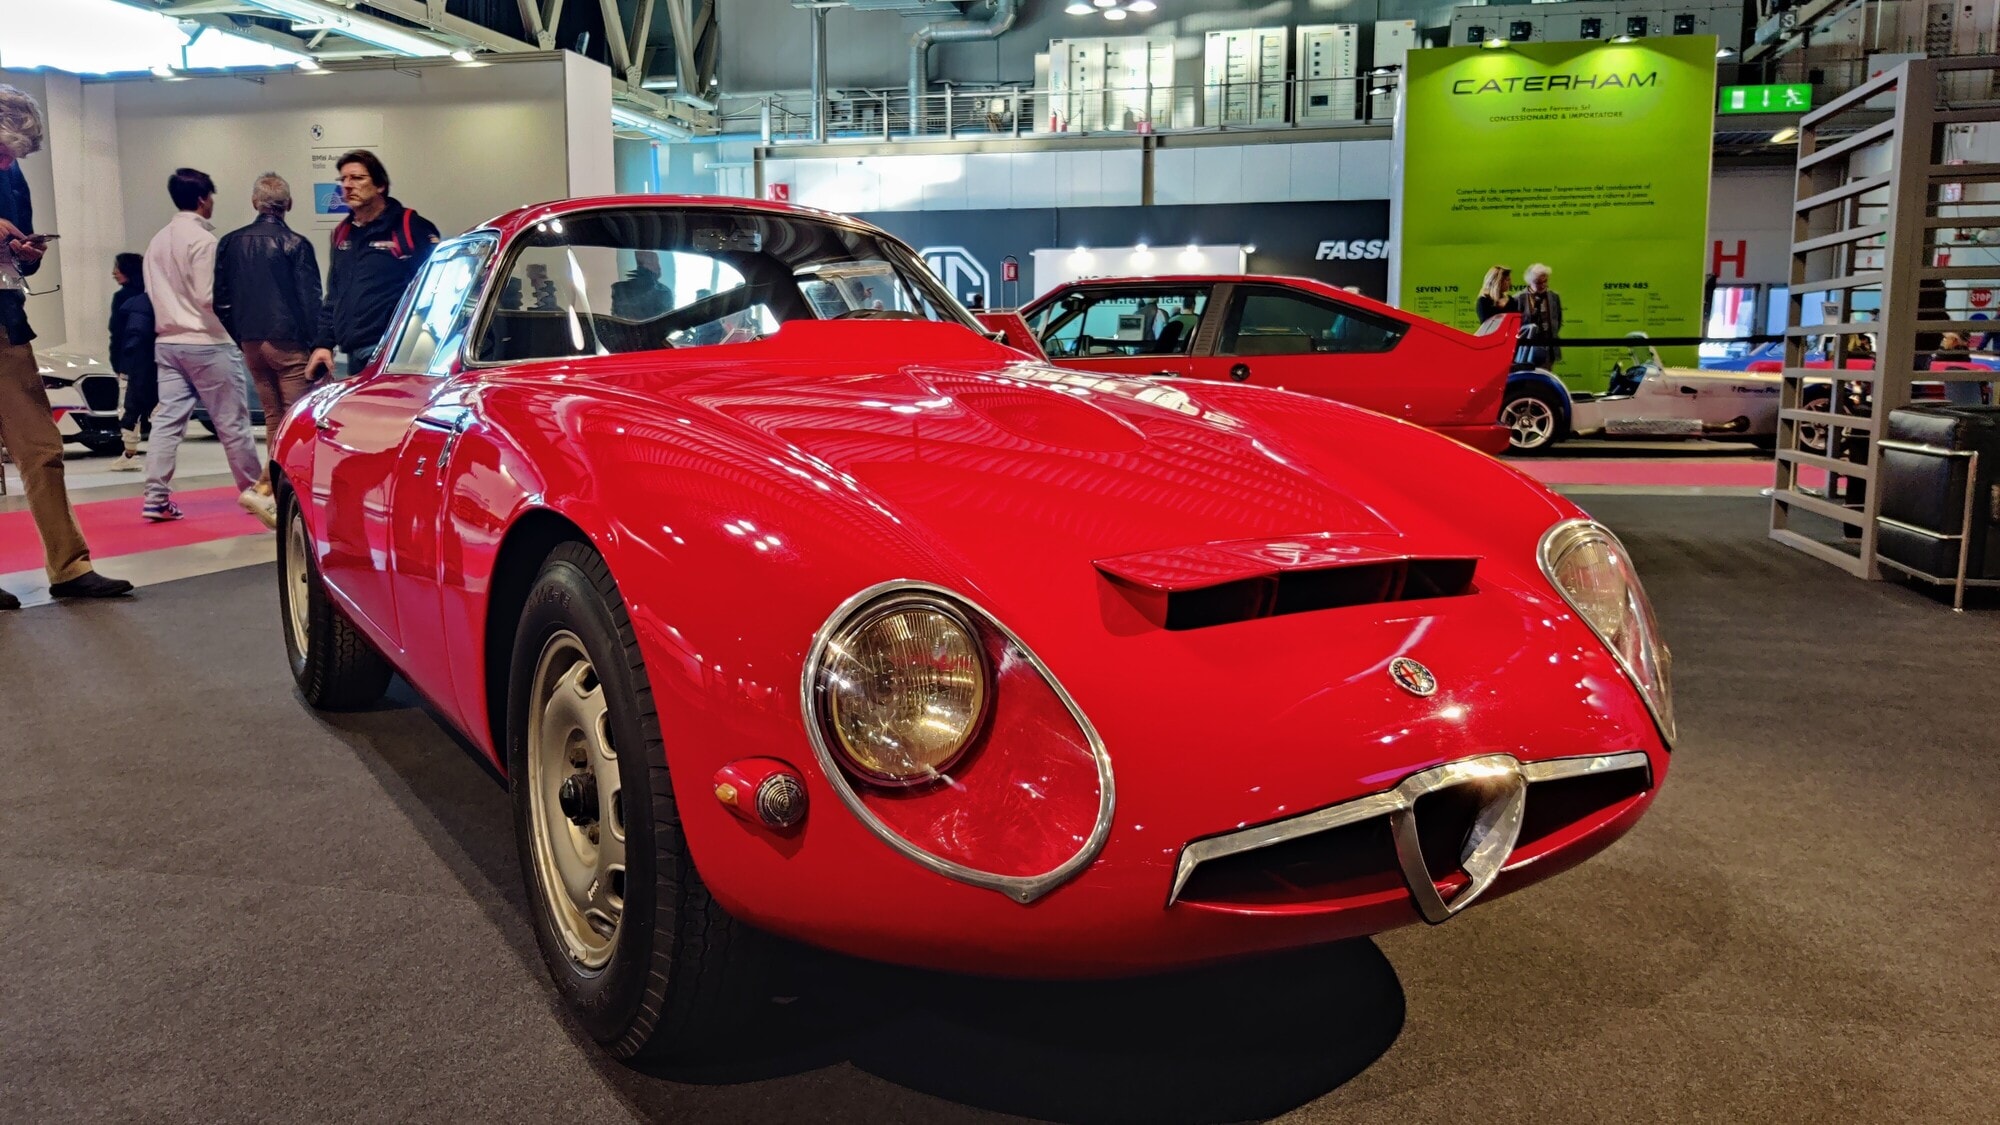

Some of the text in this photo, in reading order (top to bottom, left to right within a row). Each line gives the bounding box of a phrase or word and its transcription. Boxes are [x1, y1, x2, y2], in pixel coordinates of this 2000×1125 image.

[1452, 72, 1658, 95] CATERHAM
[1489, 113, 1558, 122] CONCESSIONARIO
[1568, 111, 1623, 120] IMPORTATORE
[1712, 240, 1746, 278] H
[1444, 285, 1459, 293] 170
[1603, 282, 1630, 290] SEVEN
[1971, 292, 1991, 302] STOP
